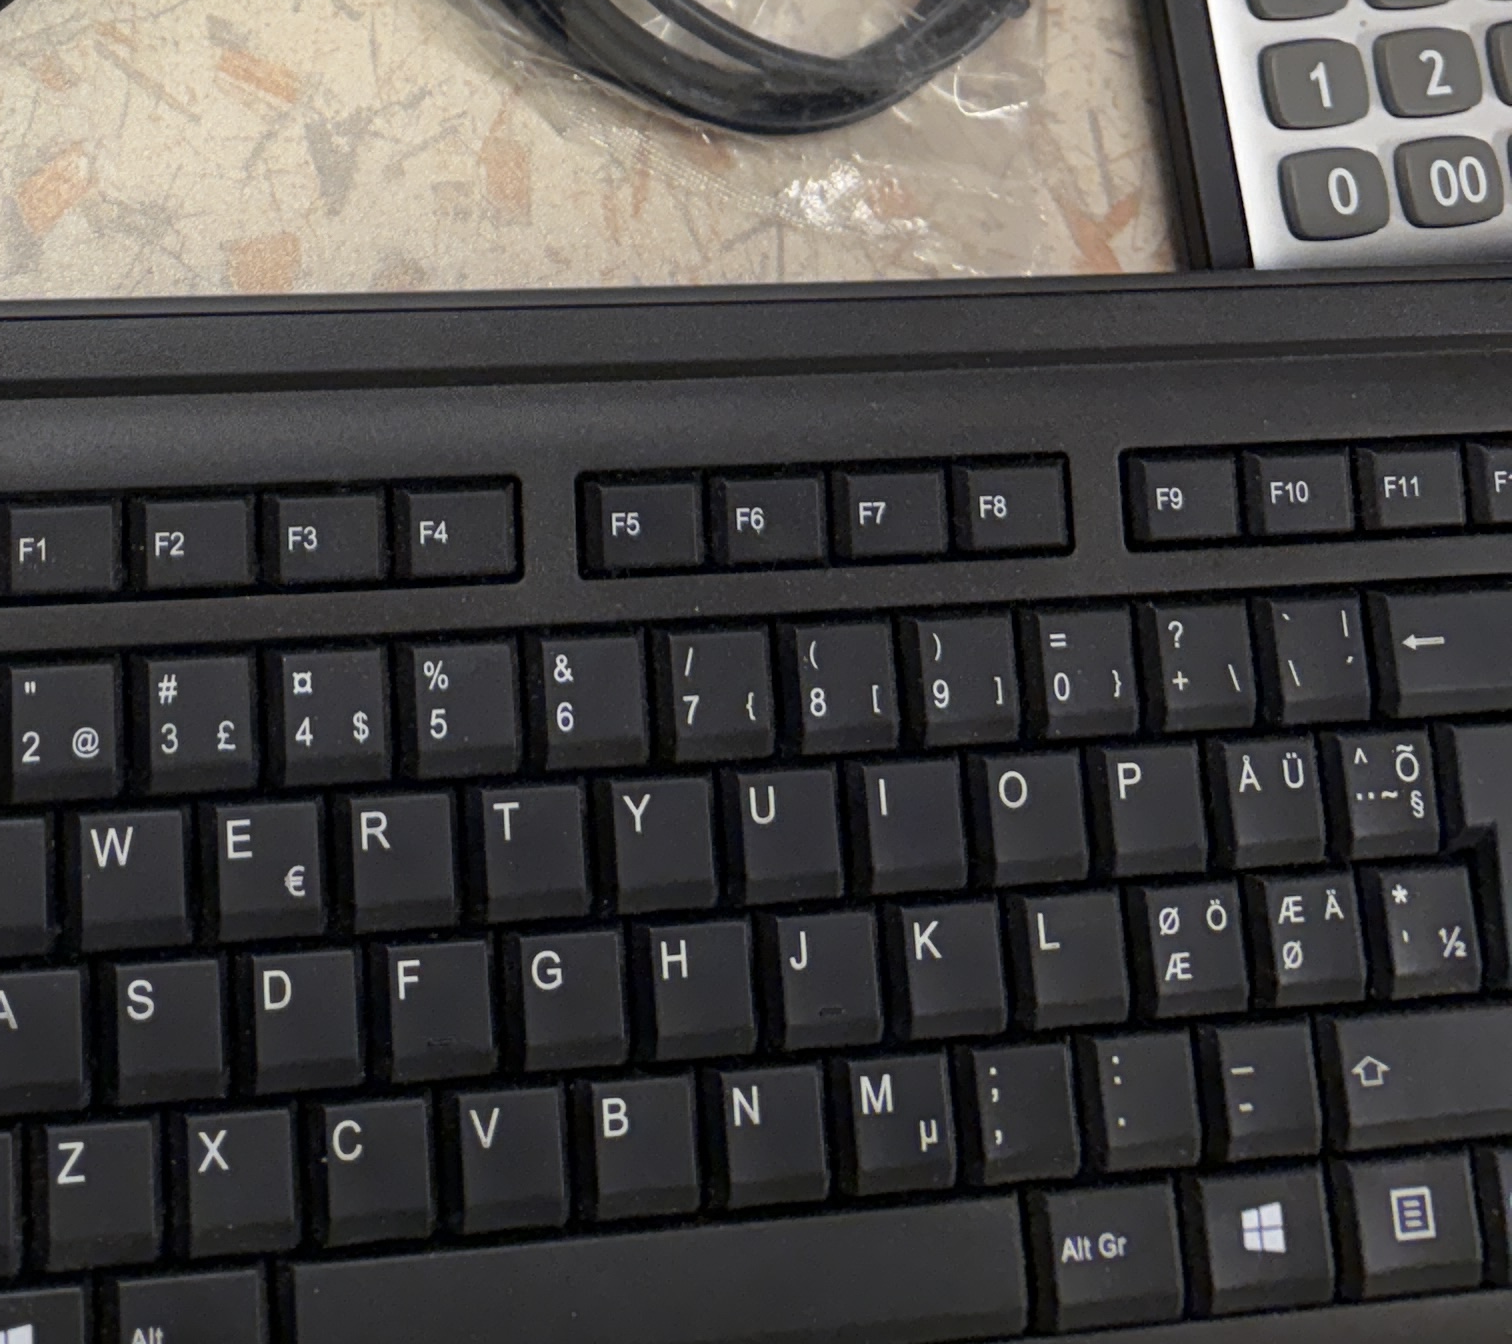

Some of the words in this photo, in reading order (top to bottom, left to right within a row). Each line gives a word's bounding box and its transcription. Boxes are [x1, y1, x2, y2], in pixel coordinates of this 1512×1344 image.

[1309, 61, 1333, 108] 1
[1419, 49, 1453, 97] 2
[1327, 167, 1359, 216] 0
[1429, 155, 1488, 207] 00
[1156, 488, 1182, 510] F9
[1271, 481, 1308, 503] F10
[1384, 476, 1419, 497] F11
[612, 512, 640, 536] F5
[736, 507, 764, 533] F6
[859, 502, 885, 524] F7
[980, 496, 1006, 518] F8
[20, 538, 45, 562] F1
[155, 532, 184, 556] F2
[289, 526, 317, 550] F3
[420, 521, 448, 544] F4
[810, 688, 826, 717] 8
[933, 680, 949, 708] 9
[1054, 673, 1070, 701] 0
[431, 709, 447, 739] 5
[557, 702, 573, 731] 6
[683, 695, 699, 724] 7
[22, 731, 40, 762] 2
[162, 723, 178, 753] 3
[296, 717, 313, 746] 4
[1118, 763, 1141, 799] P
[1240, 755, 1261, 792] Å
[1283, 753, 1304, 788] Ü
[750, 786, 775, 824] U
[879, 779, 887, 815] I
[999, 771, 1027, 808] O
[361, 811, 390, 850] R
[493, 802, 519, 840] T
[623, 794, 650, 832] Y
[91, 827, 133, 867] W
[227, 819, 252, 859] E
[914, 921, 941, 960] K
[1038, 913, 1060, 950] L
[661, 940, 687, 979] H
[790, 931, 807, 970] J
[398, 960, 420, 1000] F
[532, 951, 562, 990] G
[127, 980, 154, 1020] S
[264, 970, 291, 1010] D
[733, 1086, 760, 1126] N
[860, 1074, 893, 1114] M
[470, 1108, 499, 1148] V
[602, 1098, 628, 1137] B
[199, 1130, 228, 1172] X
[333, 1120, 362, 1160] C
[58, 1142, 85, 1184] Z
[1062, 1237, 1092, 1262] Alt
[1099, 1233, 1126, 1258] Gr
